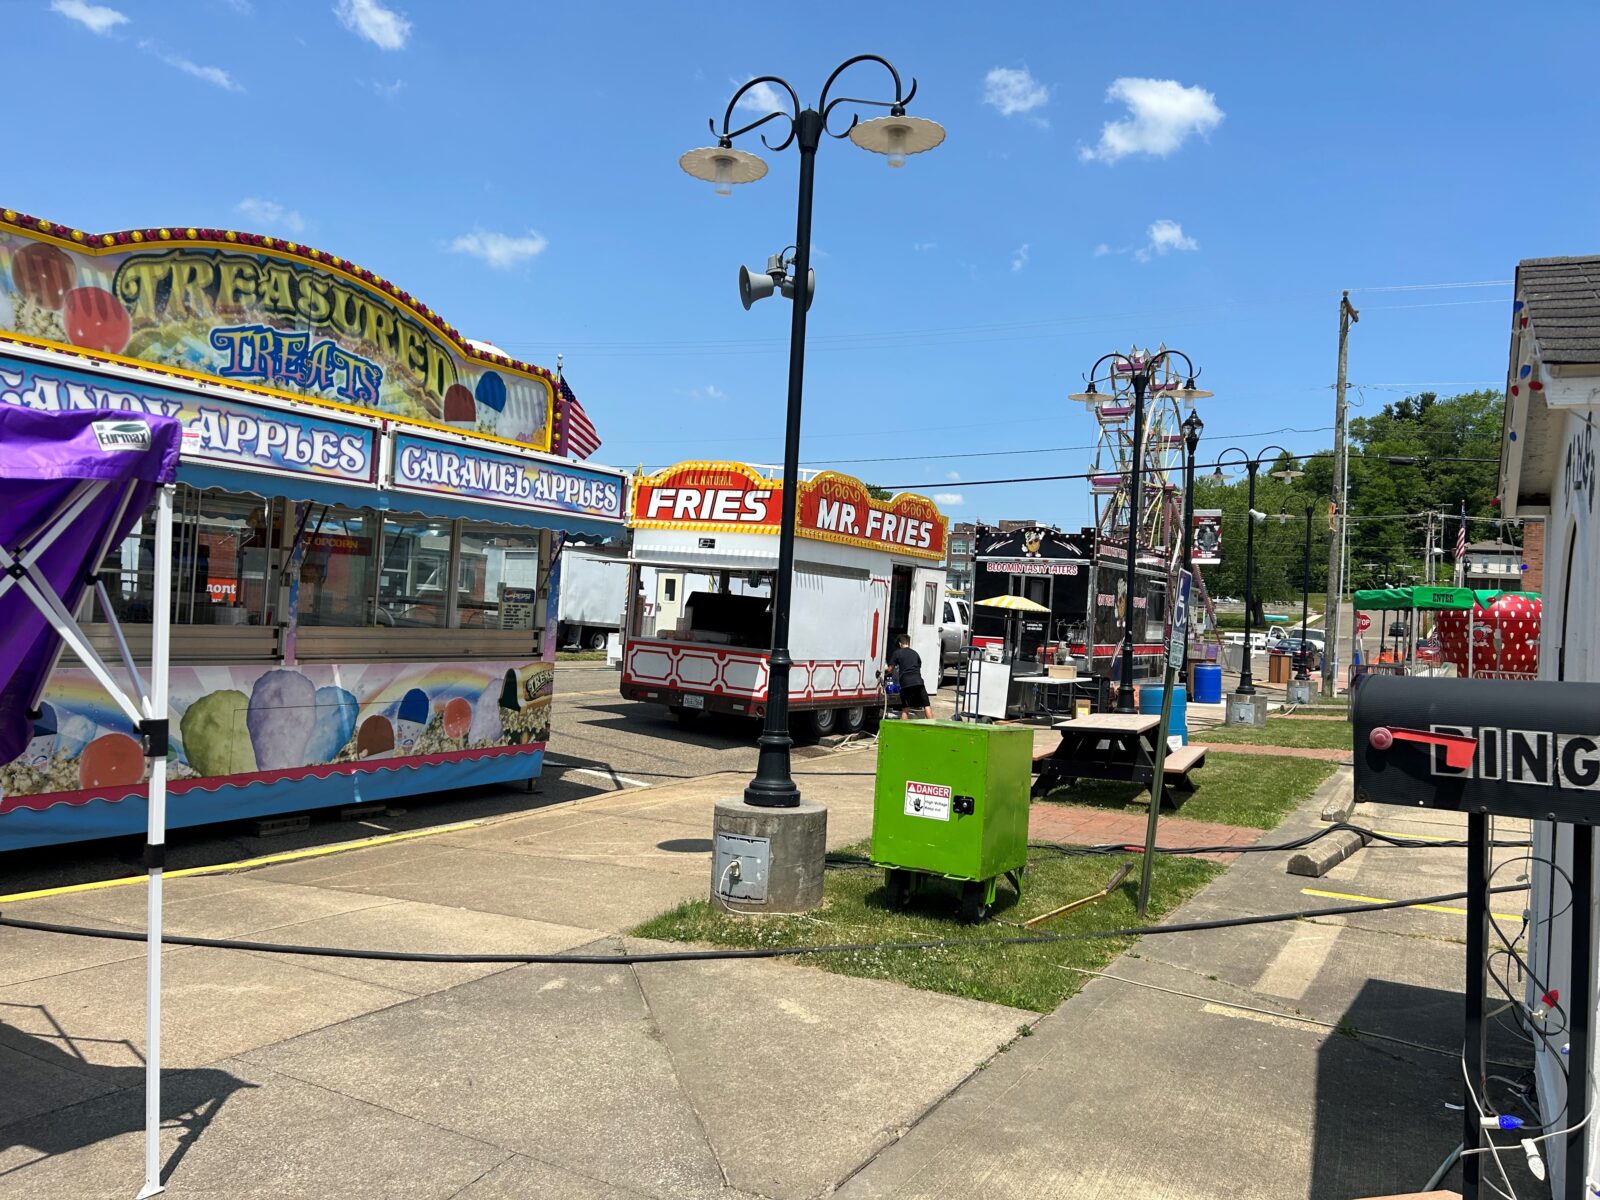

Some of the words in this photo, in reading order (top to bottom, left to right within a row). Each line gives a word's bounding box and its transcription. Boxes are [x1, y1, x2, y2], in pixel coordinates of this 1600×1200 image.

[115, 252, 450, 413] TREASURED
[211, 327, 382, 404] TREATS
[98, 432, 147, 445] Eurmax
[191, 408, 365, 473] APPLES
[400, 444, 531, 499] CARAMEL
[534, 470, 617, 513] APPLES
[686, 475, 699, 486] ALL
[700, 476, 733, 486] NATURAL
[646, 488, 772, 521] FRIES
[816, 498, 859, 535] MR.
[865, 509, 933, 548] FRIES
[302, 536, 359, 549] OPCORN
[1023, 564, 1049, 573] TASTY
[1049, 566, 1078, 575] TATERS
[1433, 593, 1454, 603] ENTER
[916, 784, 949, 797] DANGER
